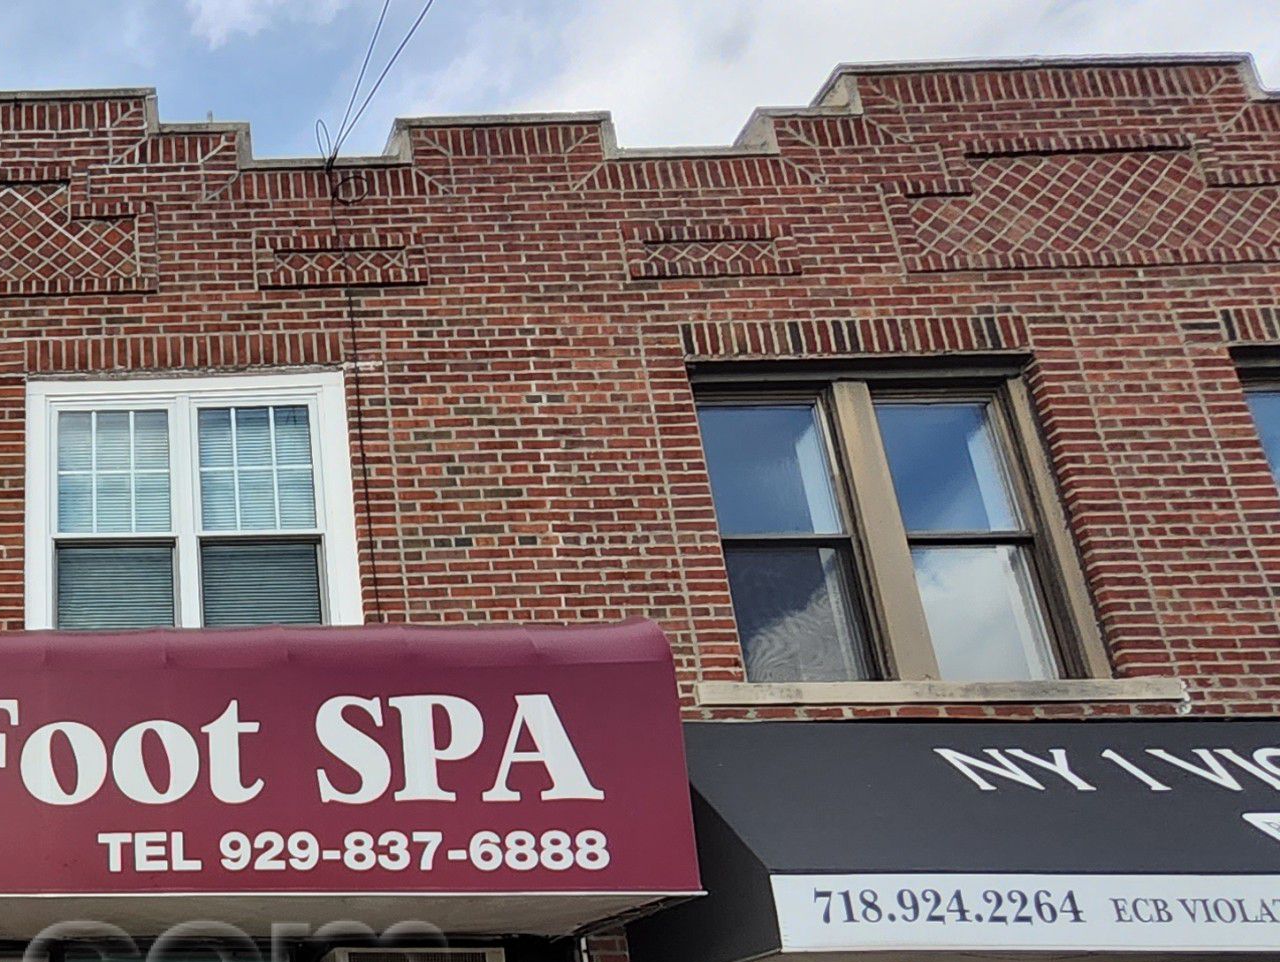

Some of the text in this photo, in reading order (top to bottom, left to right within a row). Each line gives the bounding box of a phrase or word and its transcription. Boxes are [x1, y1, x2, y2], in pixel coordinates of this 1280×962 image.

[315, 694, 606, 804] SPA
[933, 747, 1097, 791] NY
[98, 831, 202, 873] TEL
[220, 830, 611, 872] 929-837-6888
[813, 887, 1086, 925] 718.924.2264
[1109, 897, 1173, 923] ECB
